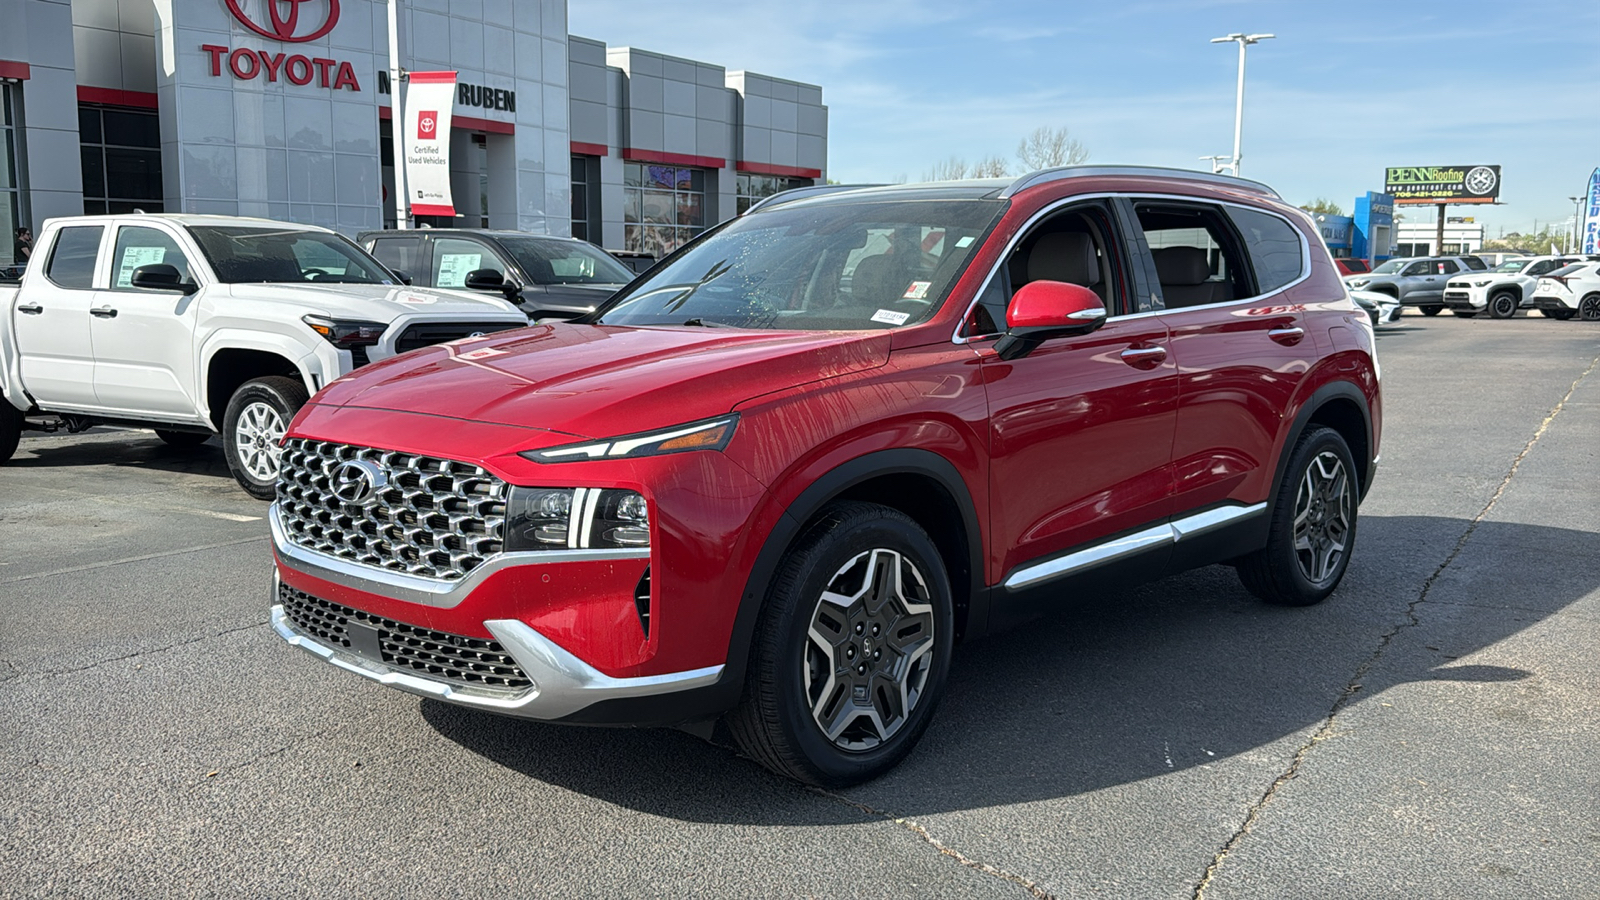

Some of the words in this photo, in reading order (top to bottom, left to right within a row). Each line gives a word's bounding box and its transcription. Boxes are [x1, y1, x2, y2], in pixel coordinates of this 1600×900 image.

[202, 44, 361, 91] TOYOTA
[458, 82, 516, 113] RUBEN
[414, 145, 439, 154] Certified
[408, 156, 422, 164] Used
[423, 156, 446, 165] Vehicles
[1387, 167, 1434, 181] PENN
[1432, 168, 1464, 183] Roofing
